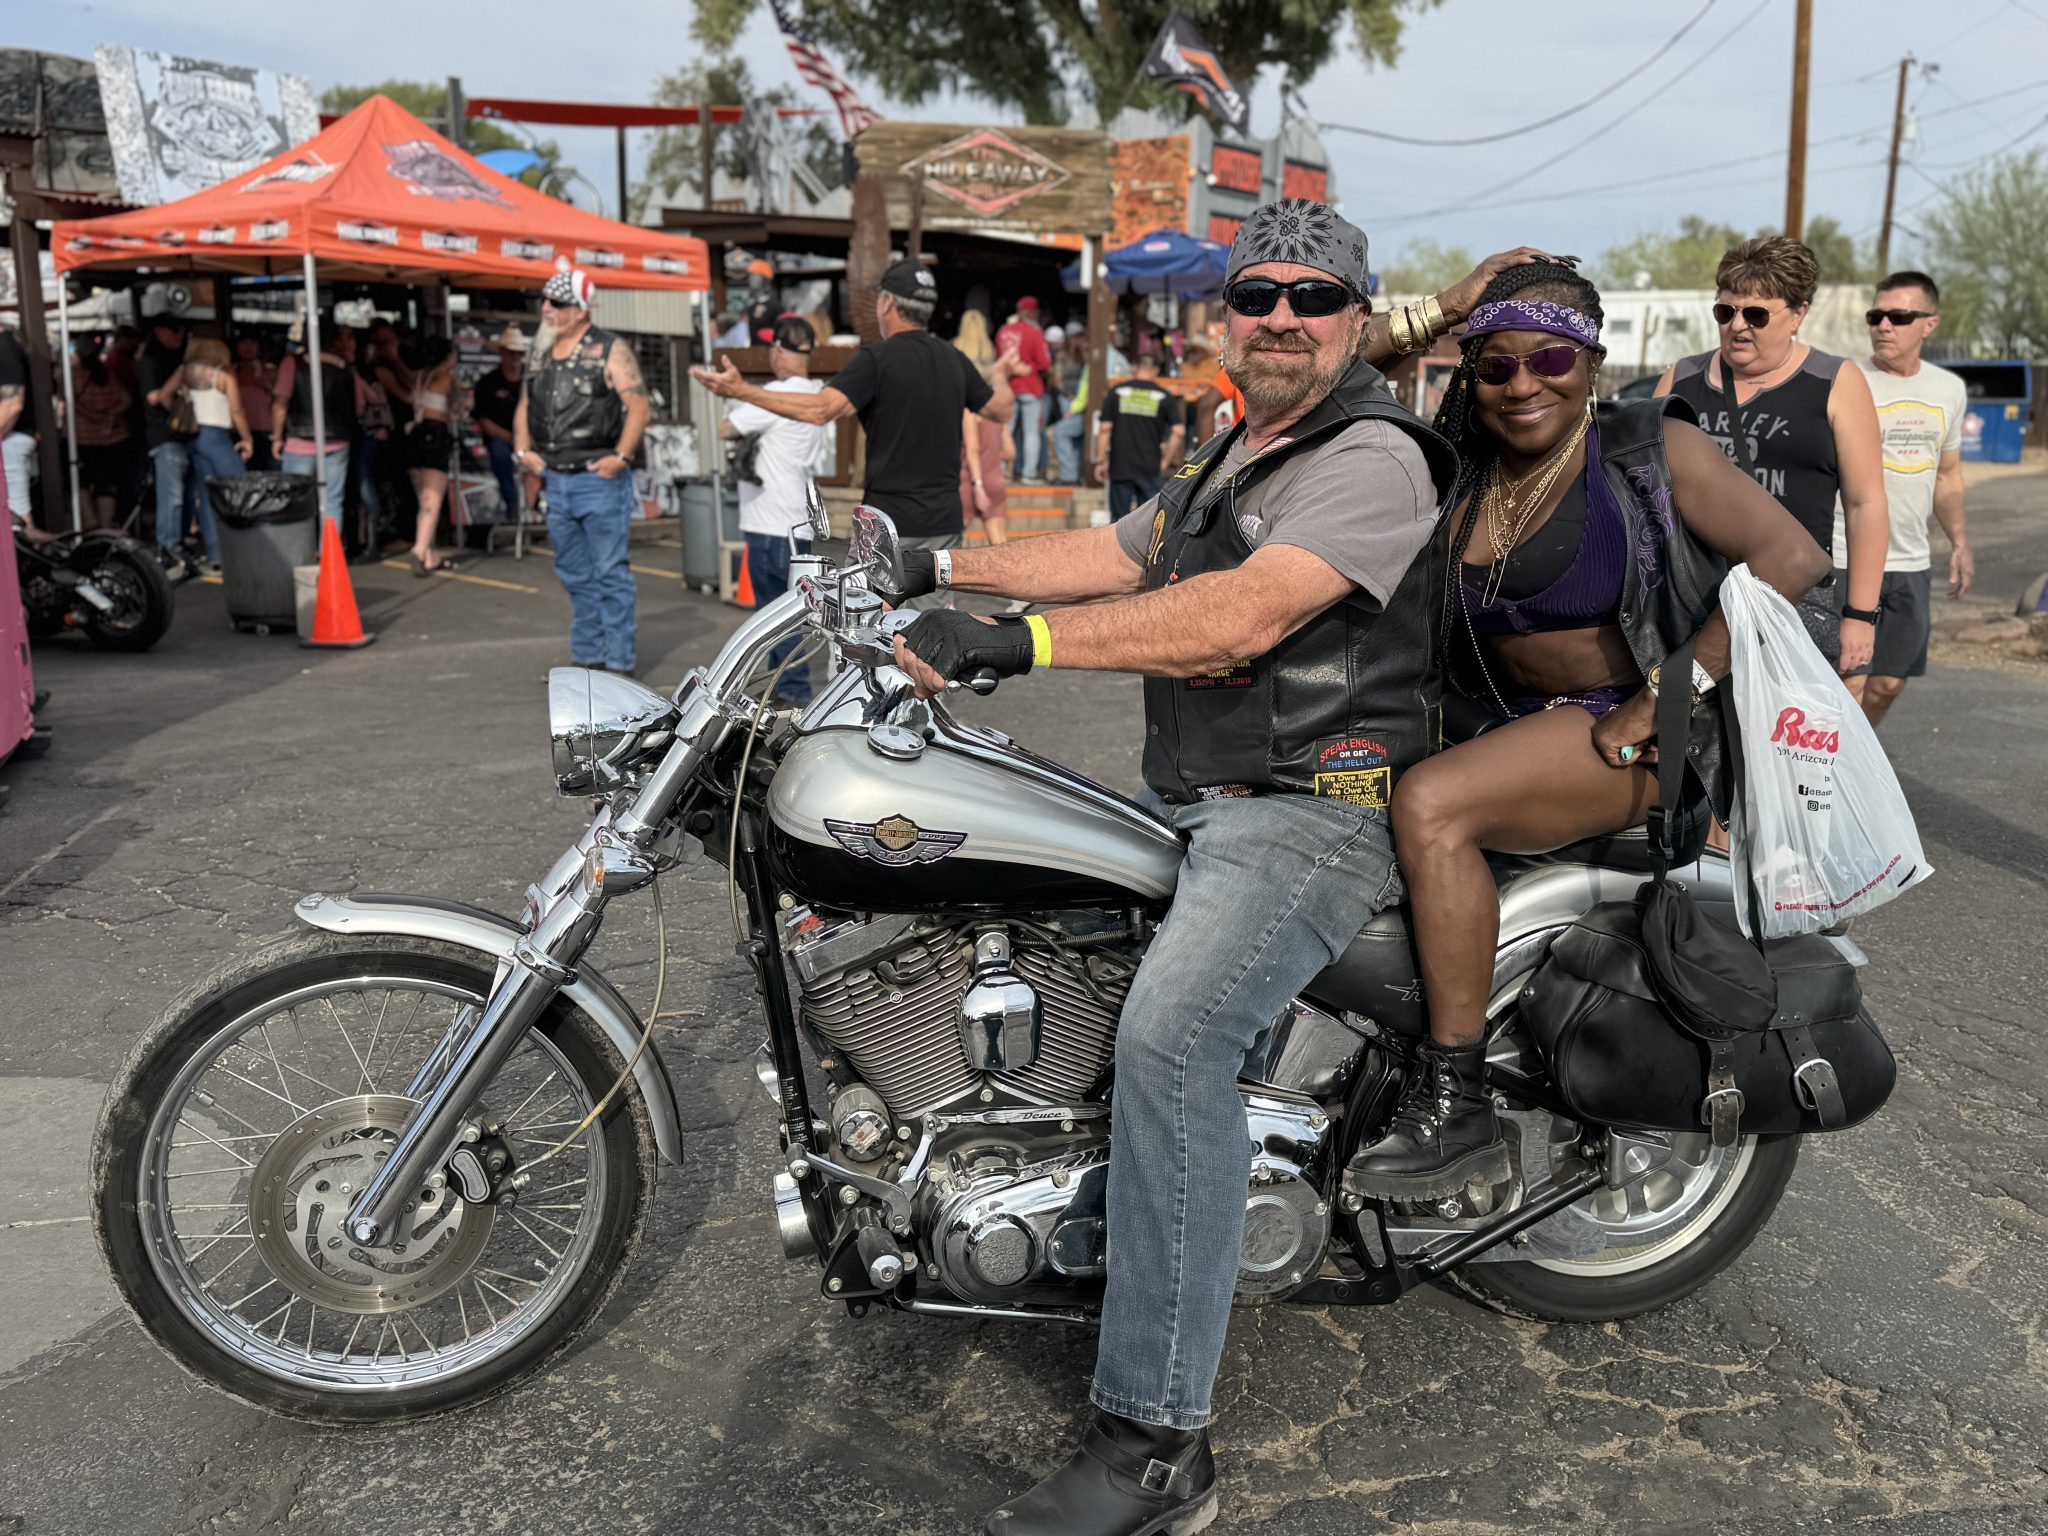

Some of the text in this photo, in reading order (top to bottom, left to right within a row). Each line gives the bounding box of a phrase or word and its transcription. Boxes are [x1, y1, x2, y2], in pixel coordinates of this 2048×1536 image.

[924, 162, 1050, 181] HIDEAWAY
[1320, 738, 1388, 763] SPEAK ENGLISH
[1353, 749, 1370, 757] GET
[1326, 756, 1383, 769] THE HELL OUT
[1333, 779, 1374, 789] NOTHING!
[1022, 1111, 1062, 1120] Deuce
